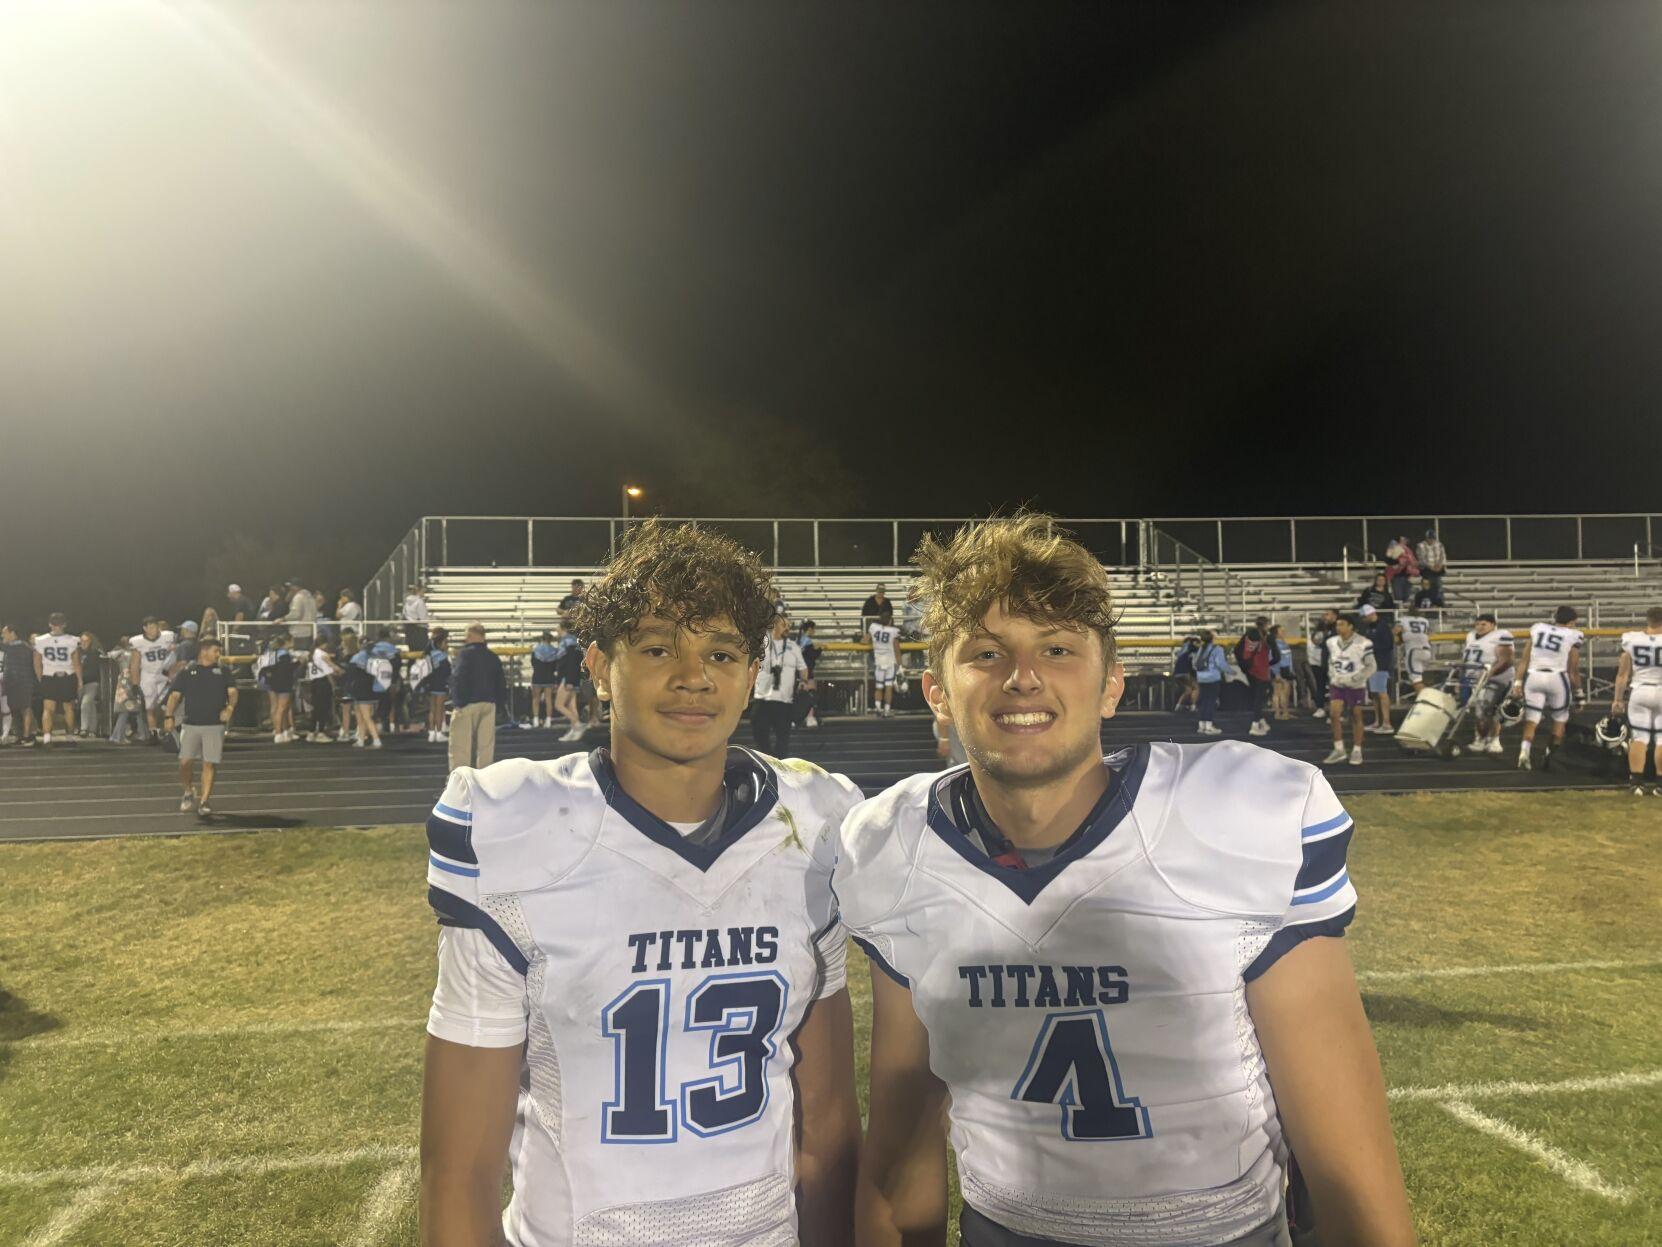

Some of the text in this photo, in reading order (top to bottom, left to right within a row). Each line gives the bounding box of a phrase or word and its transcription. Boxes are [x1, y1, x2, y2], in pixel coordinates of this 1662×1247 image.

[44, 647, 68, 661] 65
[874, 631, 890, 643] 48
[1534, 632, 1562, 652] 15
[628, 926, 779, 973] TITANS
[958, 965, 1129, 1007] TITANS
[601, 970, 789, 1144] 13
[1010, 1008, 1153, 1142] 4
